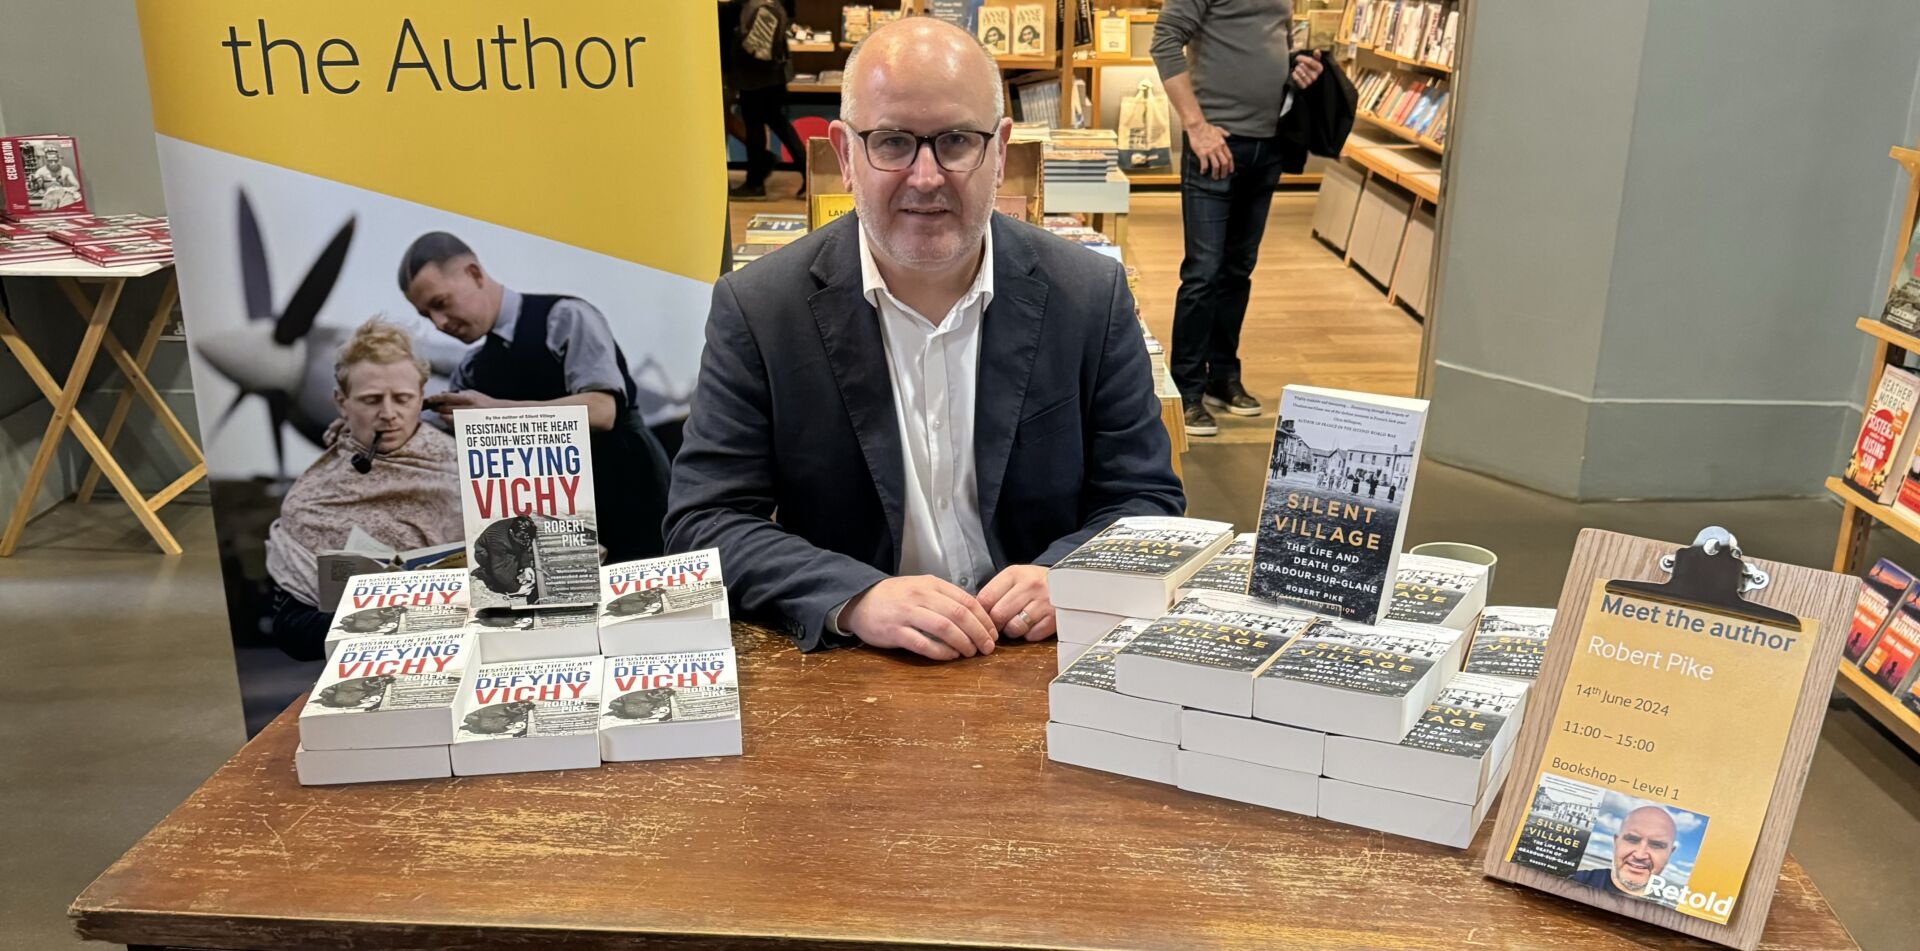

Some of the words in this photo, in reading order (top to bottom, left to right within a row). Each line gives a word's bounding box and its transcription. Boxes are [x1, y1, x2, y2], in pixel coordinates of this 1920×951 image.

[222, 19, 360, 96] the
[386, 18, 646, 92] Author
[1, 141, 15, 164] BEATON
[6, 164, 18, 180] CECIL
[1882, 379, 1913, 400] HEATHER
[1879, 393, 1906, 410] MORRIS
[466, 423, 517, 434] RESISTANCE
[520, 422, 530, 433] IN
[531, 422, 548, 432] THE
[551, 420, 578, 432] HEART
[467, 436, 478, 447] OF
[481, 434, 536, 446] SOUTH-WEST
[538, 433, 572, 444] FRANCE
[1862, 436, 1886, 460] RISING
[468, 445, 580, 479] DEFYING
[1861, 453, 1877, 472] SUN
[471, 476, 580, 519] VICHY
[1288, 492, 1376, 524] SILENT
[544, 520, 585, 534] ROBERT
[1274, 514, 1381, 550] VILLAGE
[562, 534, 587, 547] PIKE
[1104, 538, 1181, 549] SILENT
[1090, 546, 1182, 556] VILLAGE
[1286, 542, 1306, 554] THE
[1310, 547, 1332, 559] LIFE
[1336, 553, 1360, 564] AND
[610, 561, 710, 584] DEFYING
[1294, 558, 1328, 570] DEATH
[1332, 564, 1348, 574] OF
[610, 568, 708, 596] VICHY
[1260, 562, 1378, 594] ORADOUR-SUR-GLANE
[353, 582, 462, 596] DEFYING
[1286, 584, 1320, 598] ROBERT
[1324, 592, 1344, 602] PIKE
[353, 591, 459, 608] VICHY
[1178, 618, 1266, 638] SILENT
[1600, 594, 1661, 624] Meet
[1666, 608, 1705, 632] the
[1710, 622, 1797, 652] author
[348, 640, 400, 648] RESISTANCE
[360, 642, 416, 651] SOUTH-WEST
[1161, 626, 1268, 648] VILLAGE
[1174, 640, 1210, 650] DEATH
[1192, 638, 1216, 646] LIFE
[340, 644, 460, 663] DEFYING
[1136, 641, 1258, 662] ORADOUR-SUR-GLANE
[1299, 648, 1415, 673] VILLAGE
[1316, 642, 1412, 662] SILENT
[1587, 635, 1662, 670] Robert
[1666, 652, 1714, 681] Pike
[338, 656, 454, 678] VICHY
[614, 661, 724, 678] DEFYING
[1310, 658, 1332, 666] THE
[1334, 662, 1360, 670] LIFE
[1316, 664, 1354, 673] DEATH
[404, 673, 452, 682] ROBERT
[475, 670, 590, 690] DEFYING
[615, 670, 722, 692] VICHY
[1276, 665, 1408, 688] ORADOUR-SUR-GLANE
[476, 682, 588, 704] VICHY
[1576, 684, 1601, 698] 14th
[1601, 690, 1632, 708] June
[1634, 698, 1670, 716] 2024
[544, 700, 588, 708] ROBERT
[1434, 726, 1461, 734] AND
[1563, 720, 1602, 739] 11:00
[1616, 734, 1655, 752] 15:00
[1552, 756, 1617, 784] Bookshop
[1632, 778, 1668, 798] Level
[1671, 788, 1680, 800] 1
[1536, 818, 1580, 836] SILENT
[1529, 827, 1580, 848] VILLAGE
[1544, 842, 1555, 850] LIFE
[1518, 847, 1576, 867] ORADOUR-SUR-GLANE
[1536, 846, 1552, 854] DEATH
[1644, 874, 1734, 916] Retold
